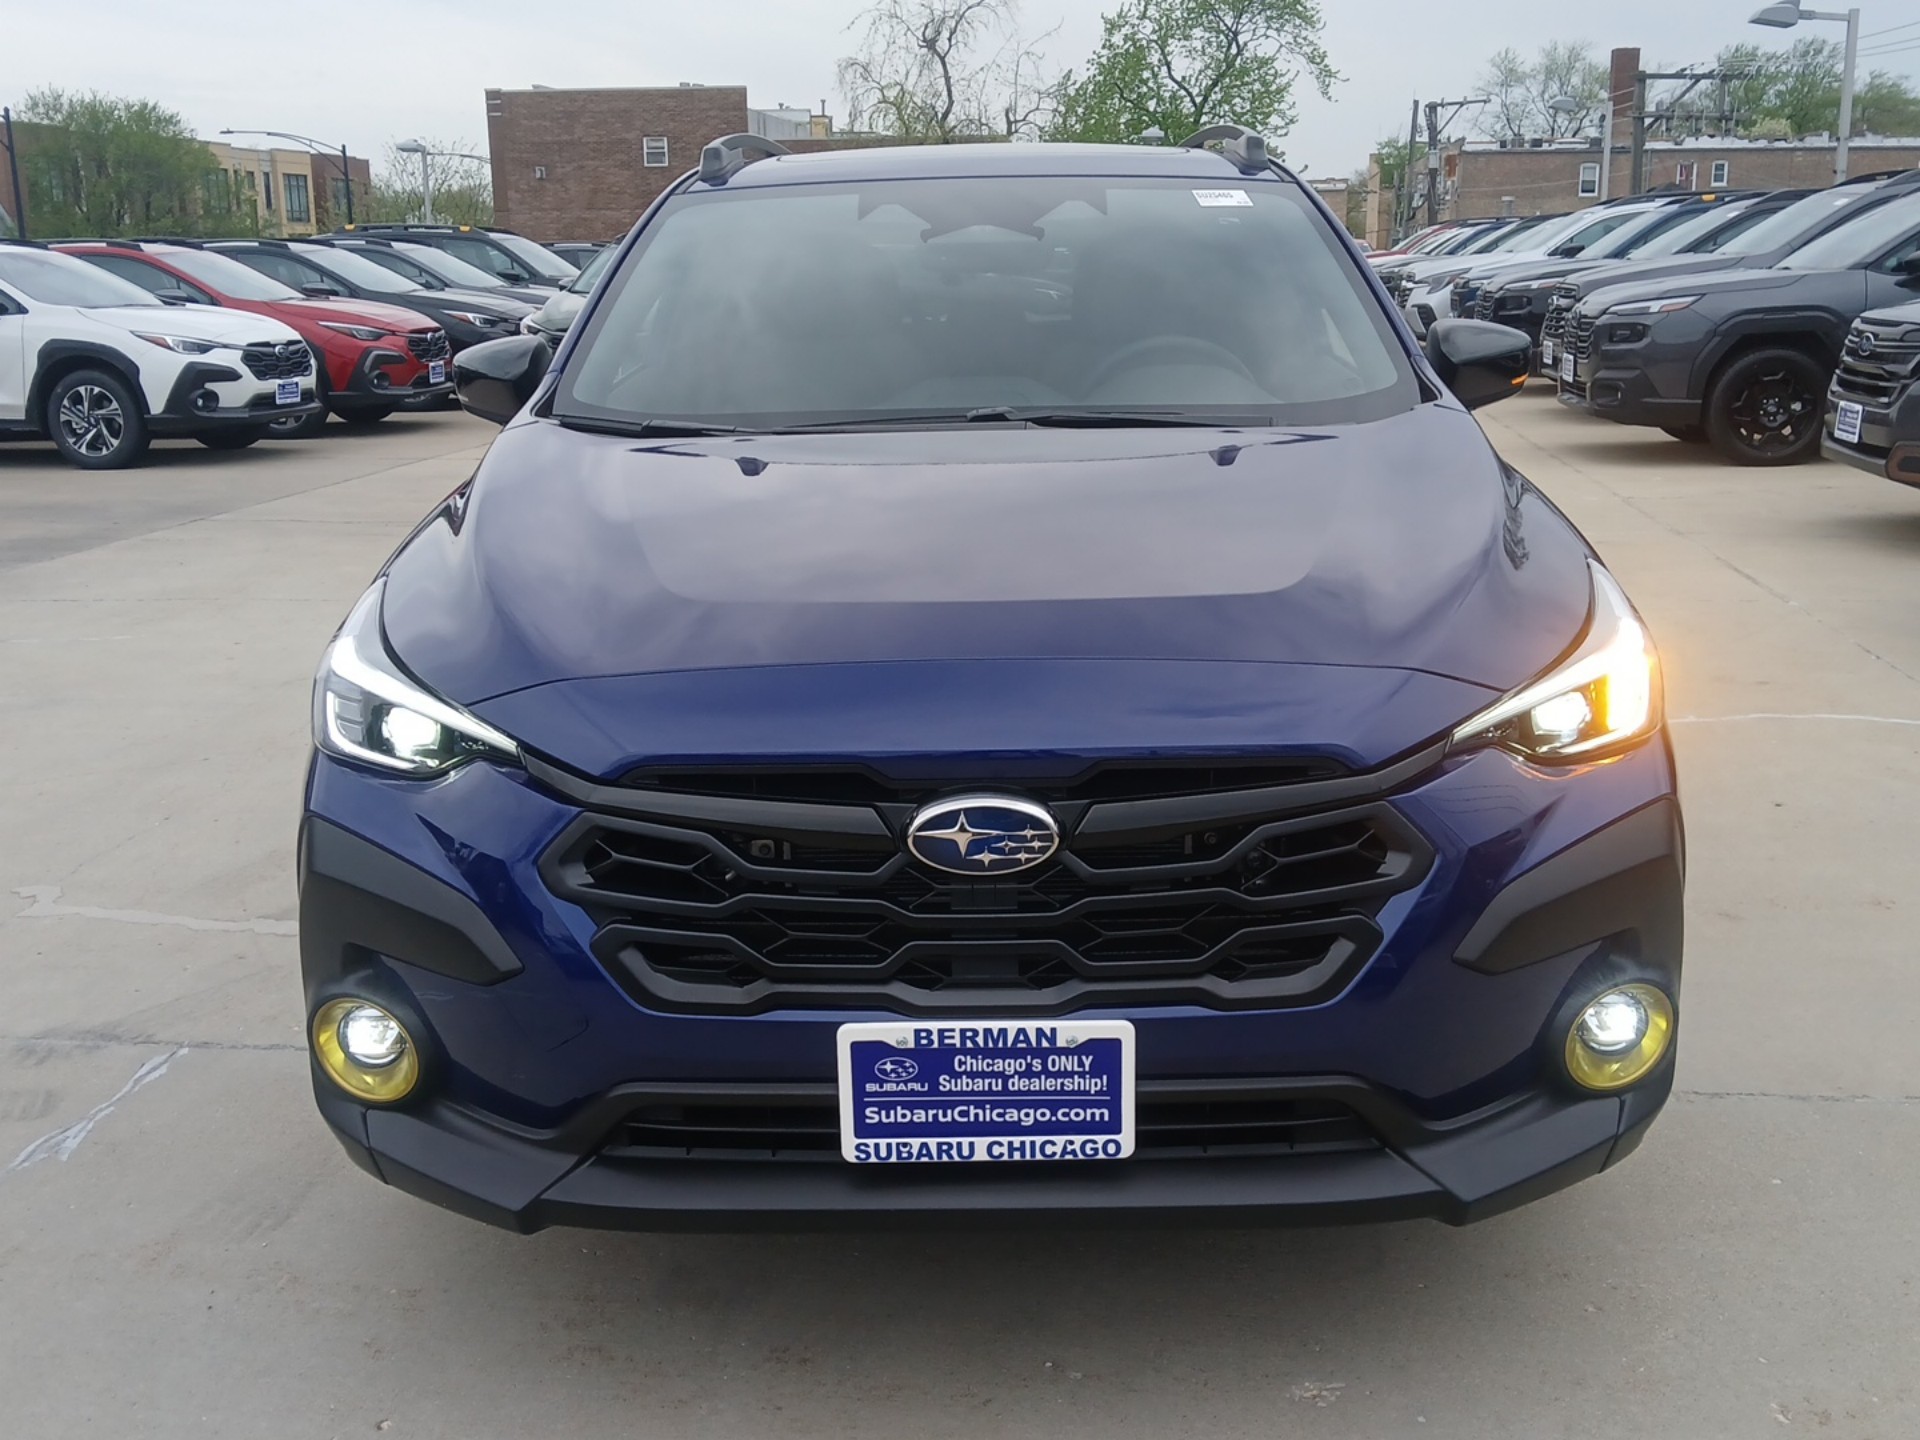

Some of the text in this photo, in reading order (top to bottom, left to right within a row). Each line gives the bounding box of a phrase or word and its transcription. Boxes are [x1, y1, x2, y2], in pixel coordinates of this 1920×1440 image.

[913, 1027, 1058, 1048] BERMAN
[954, 1055, 1094, 1075] Chicago's ONLY
[865, 1082, 929, 1092] SUBARU
[938, 1074, 1109, 1094] Subaru dealership!
[864, 1104, 1110, 1126] SubaruChicago.com
[854, 1138, 1123, 1162] SUBARU CHICAGO
